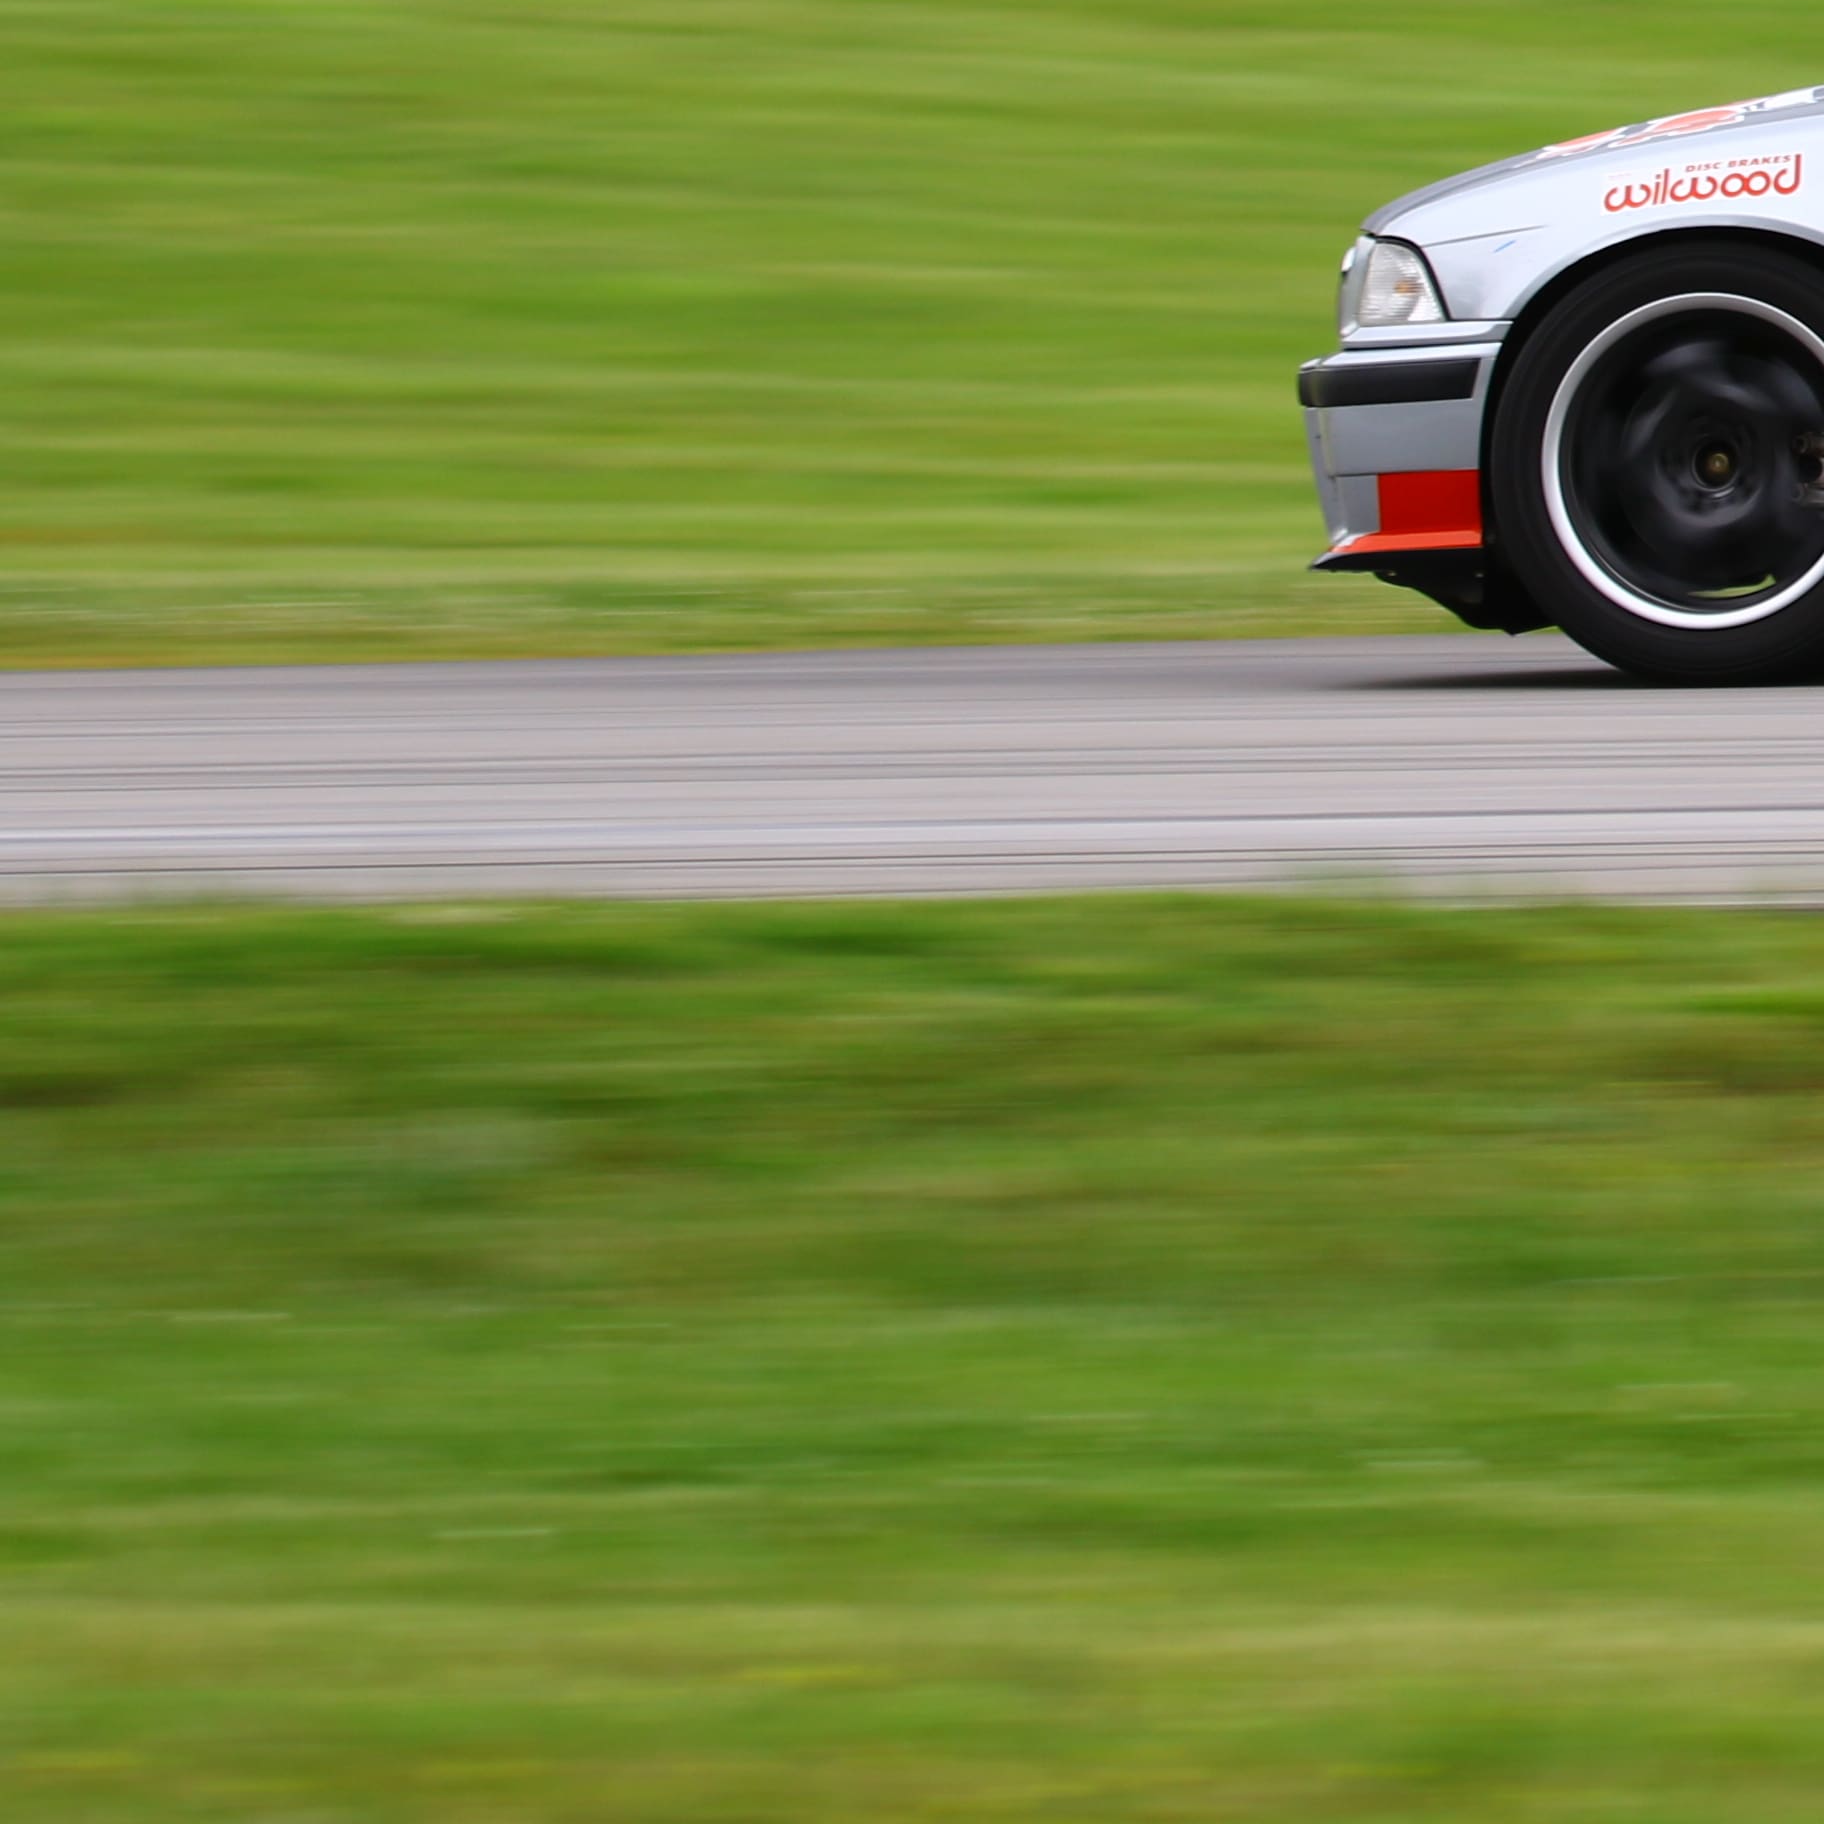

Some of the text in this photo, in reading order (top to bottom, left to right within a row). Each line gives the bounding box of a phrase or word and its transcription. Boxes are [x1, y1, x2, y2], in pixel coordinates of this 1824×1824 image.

[1604, 153, 1802, 212] wilwood
[1685, 154, 1792, 173] DISC BRAKES
